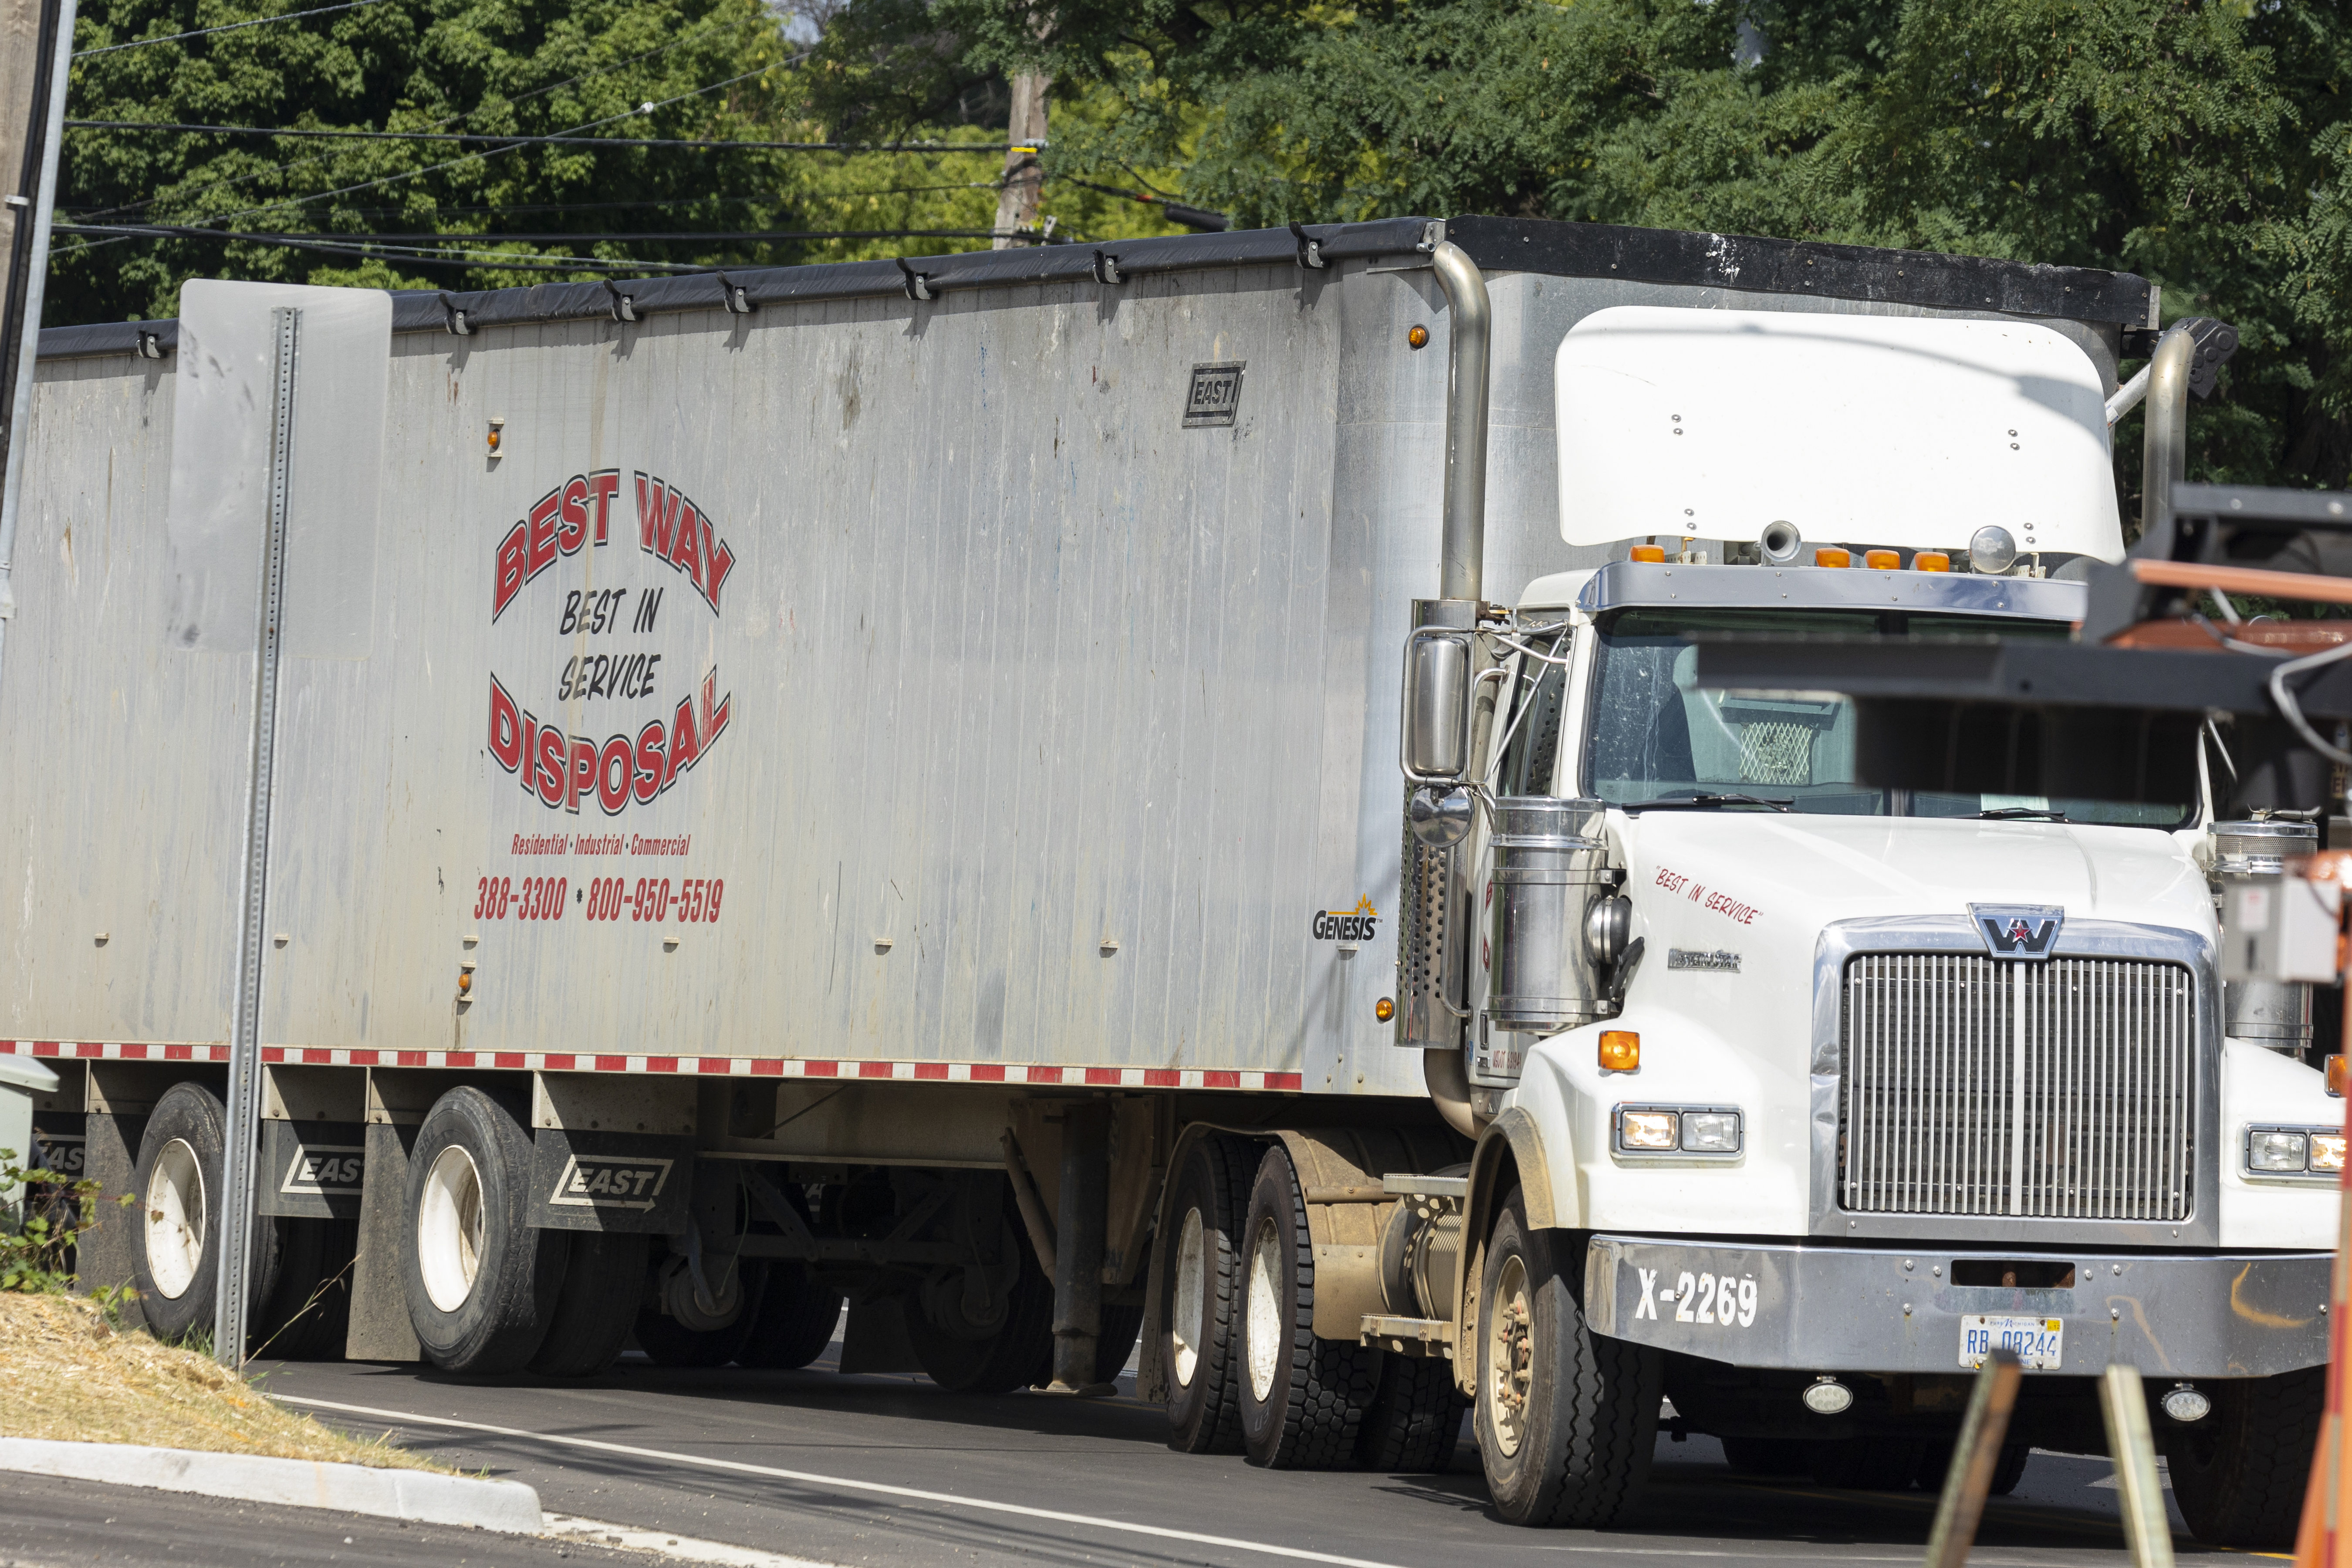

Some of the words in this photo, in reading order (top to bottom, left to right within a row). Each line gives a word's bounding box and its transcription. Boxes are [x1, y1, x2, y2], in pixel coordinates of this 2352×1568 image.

[1194, 380, 1232, 404] EAST
[493, 468, 620, 626] BEST
[634, 470, 736, 618] WAY
[560, 588, 626, 635] BEST
[633, 587, 664, 633] IN
[558, 653, 661, 701] SERVICE
[488, 663, 731, 817] DISPOSAL
[511, 833, 568, 855] Residential
[574, 834, 625, 855] Industrial
[630, 833, 691, 856] Commercial
[474, 876, 567, 920] 388-3300
[586, 877, 723, 923] 800-950-5519
[1688, 884, 1706, 902] IN
[1313, 909, 1377, 941] GENESIS
[1493, 1050, 1506, 1068] USDOT
[297, 1157, 365, 1183] EAS
[568, 1168, 656, 1195] EAST
[1635, 1267, 1758, 1328] X-2269
[1999, 1318, 2035, 1328] MICHIGAN
[1967, 1329, 1989, 1354] RB
[2001, 1331, 2056, 1356] 08244
